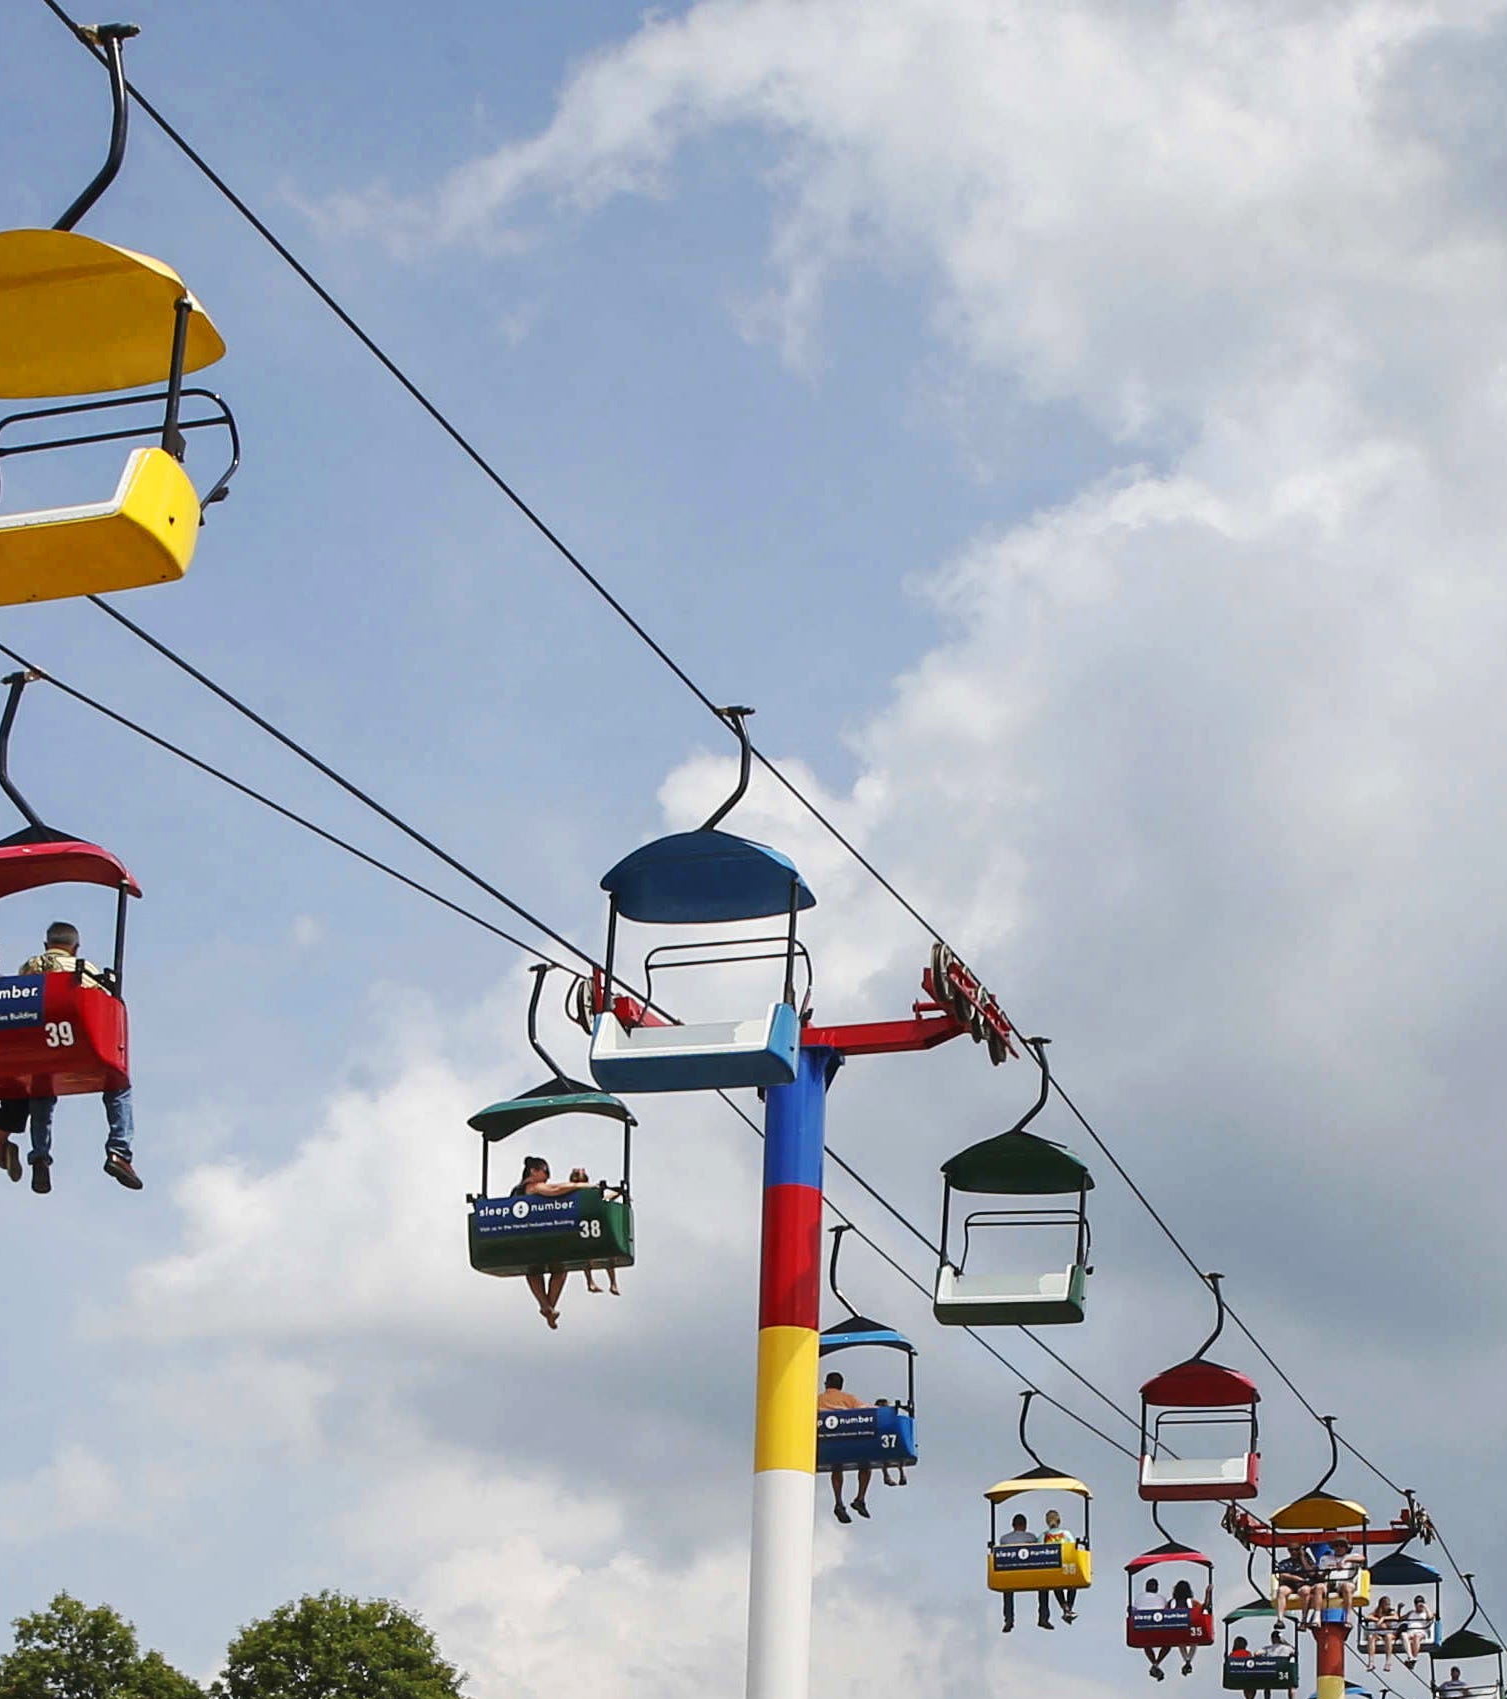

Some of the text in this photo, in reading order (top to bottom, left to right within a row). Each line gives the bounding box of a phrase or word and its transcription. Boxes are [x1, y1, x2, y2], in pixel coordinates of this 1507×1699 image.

[9, 1011, 38, 1021] Building
[45, 1021, 75, 1048] 39
[479, 1206, 510, 1218] sleep
[579, 1219, 601, 1239] 38
[840, 1415, 874, 1425] number
[881, 1434, 897, 1448] 37
[996, 1550, 1017, 1559] sleep
[1190, 1626, 1203, 1637] 35
[1278, 1671, 1289, 1681] 34
